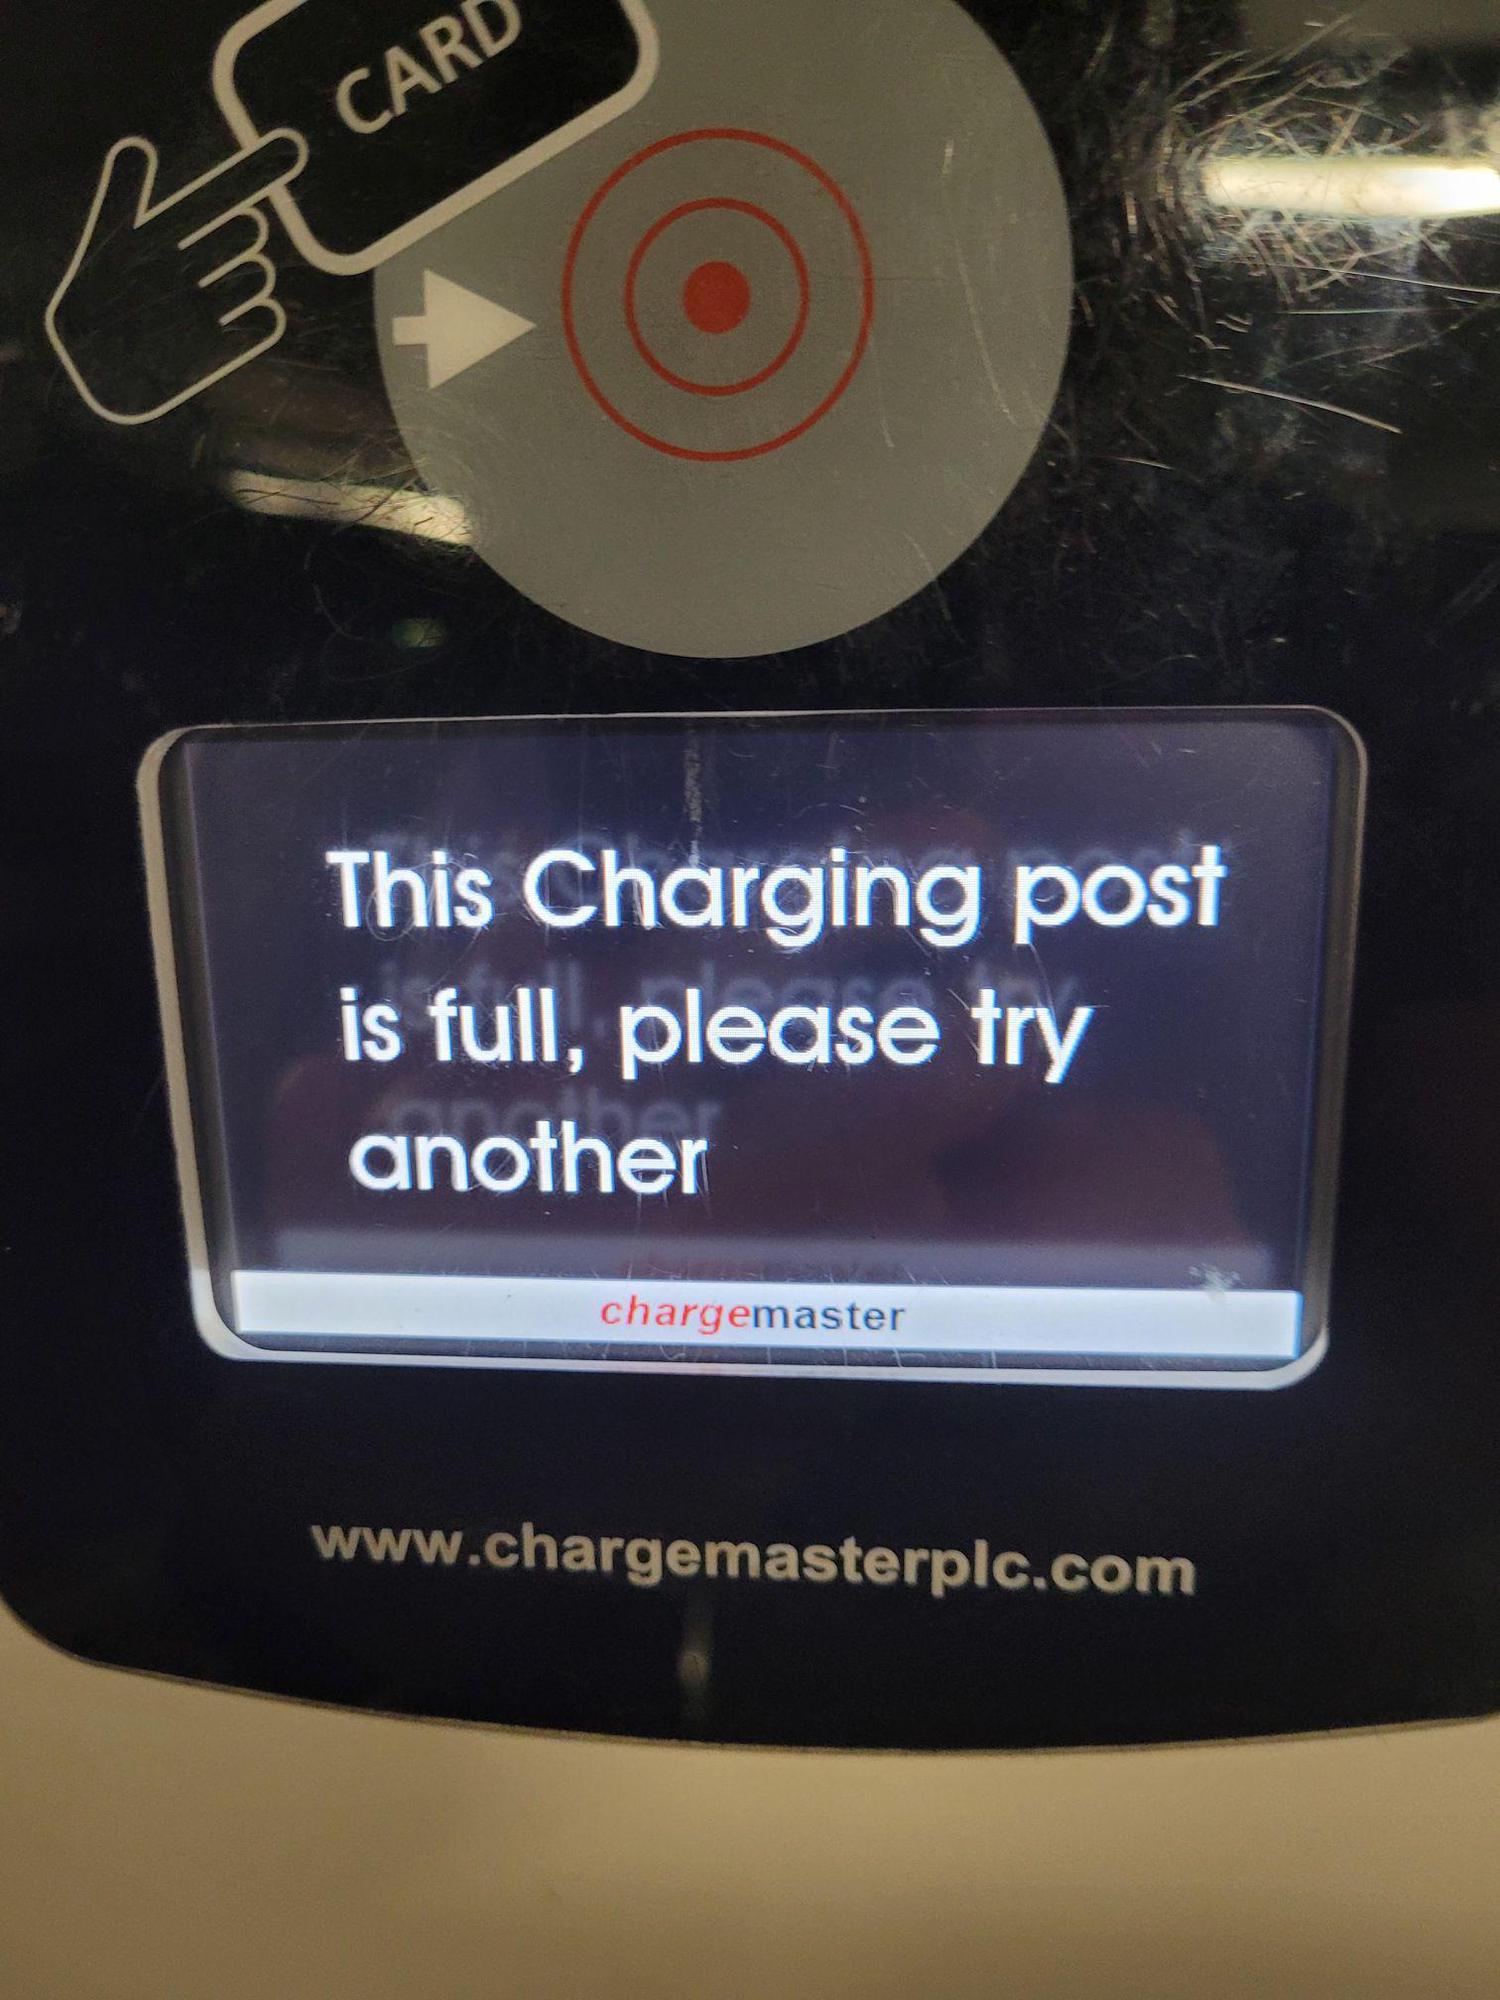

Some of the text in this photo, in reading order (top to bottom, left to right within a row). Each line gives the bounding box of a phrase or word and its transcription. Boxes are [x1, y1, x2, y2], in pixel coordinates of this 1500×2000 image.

[335, 0, 523, 135] CARD
[325, 844, 1229, 948] This Charging post
[339, 986, 1095, 1085] is full, please try
[348, 1119, 709, 1195] another
[599, 1293, 907, 1335] chargemaster
[310, 1520, 1197, 1599] www.chargemasterplc.com
